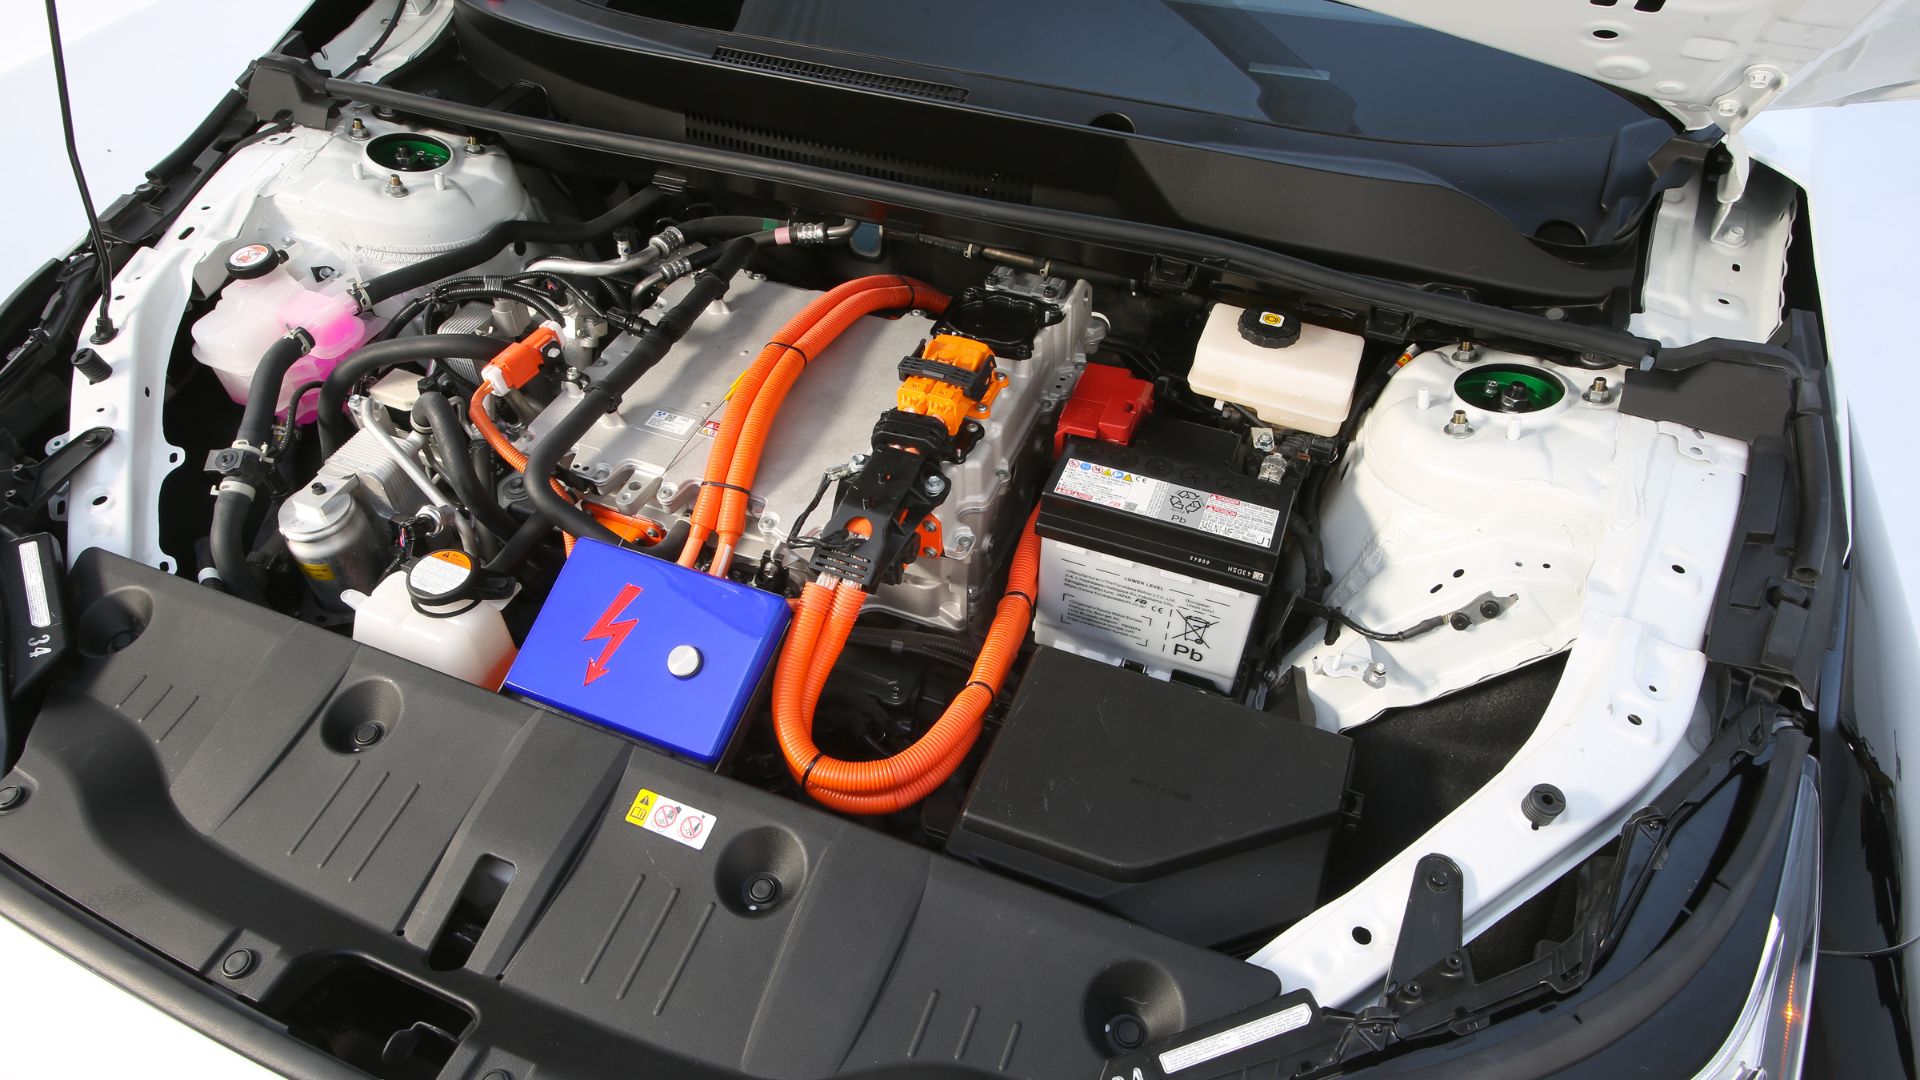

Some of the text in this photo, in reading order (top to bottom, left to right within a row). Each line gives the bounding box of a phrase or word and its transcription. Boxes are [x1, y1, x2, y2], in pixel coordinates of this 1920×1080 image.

[1171, 514, 1187, 524] Pb
[1257, 536, 1271, 547] J1
[1124, 576, 1163, 591] LOWER LEVEL
[27, 633, 52, 658] 34
[1173, 643, 1203, 662] Pb
